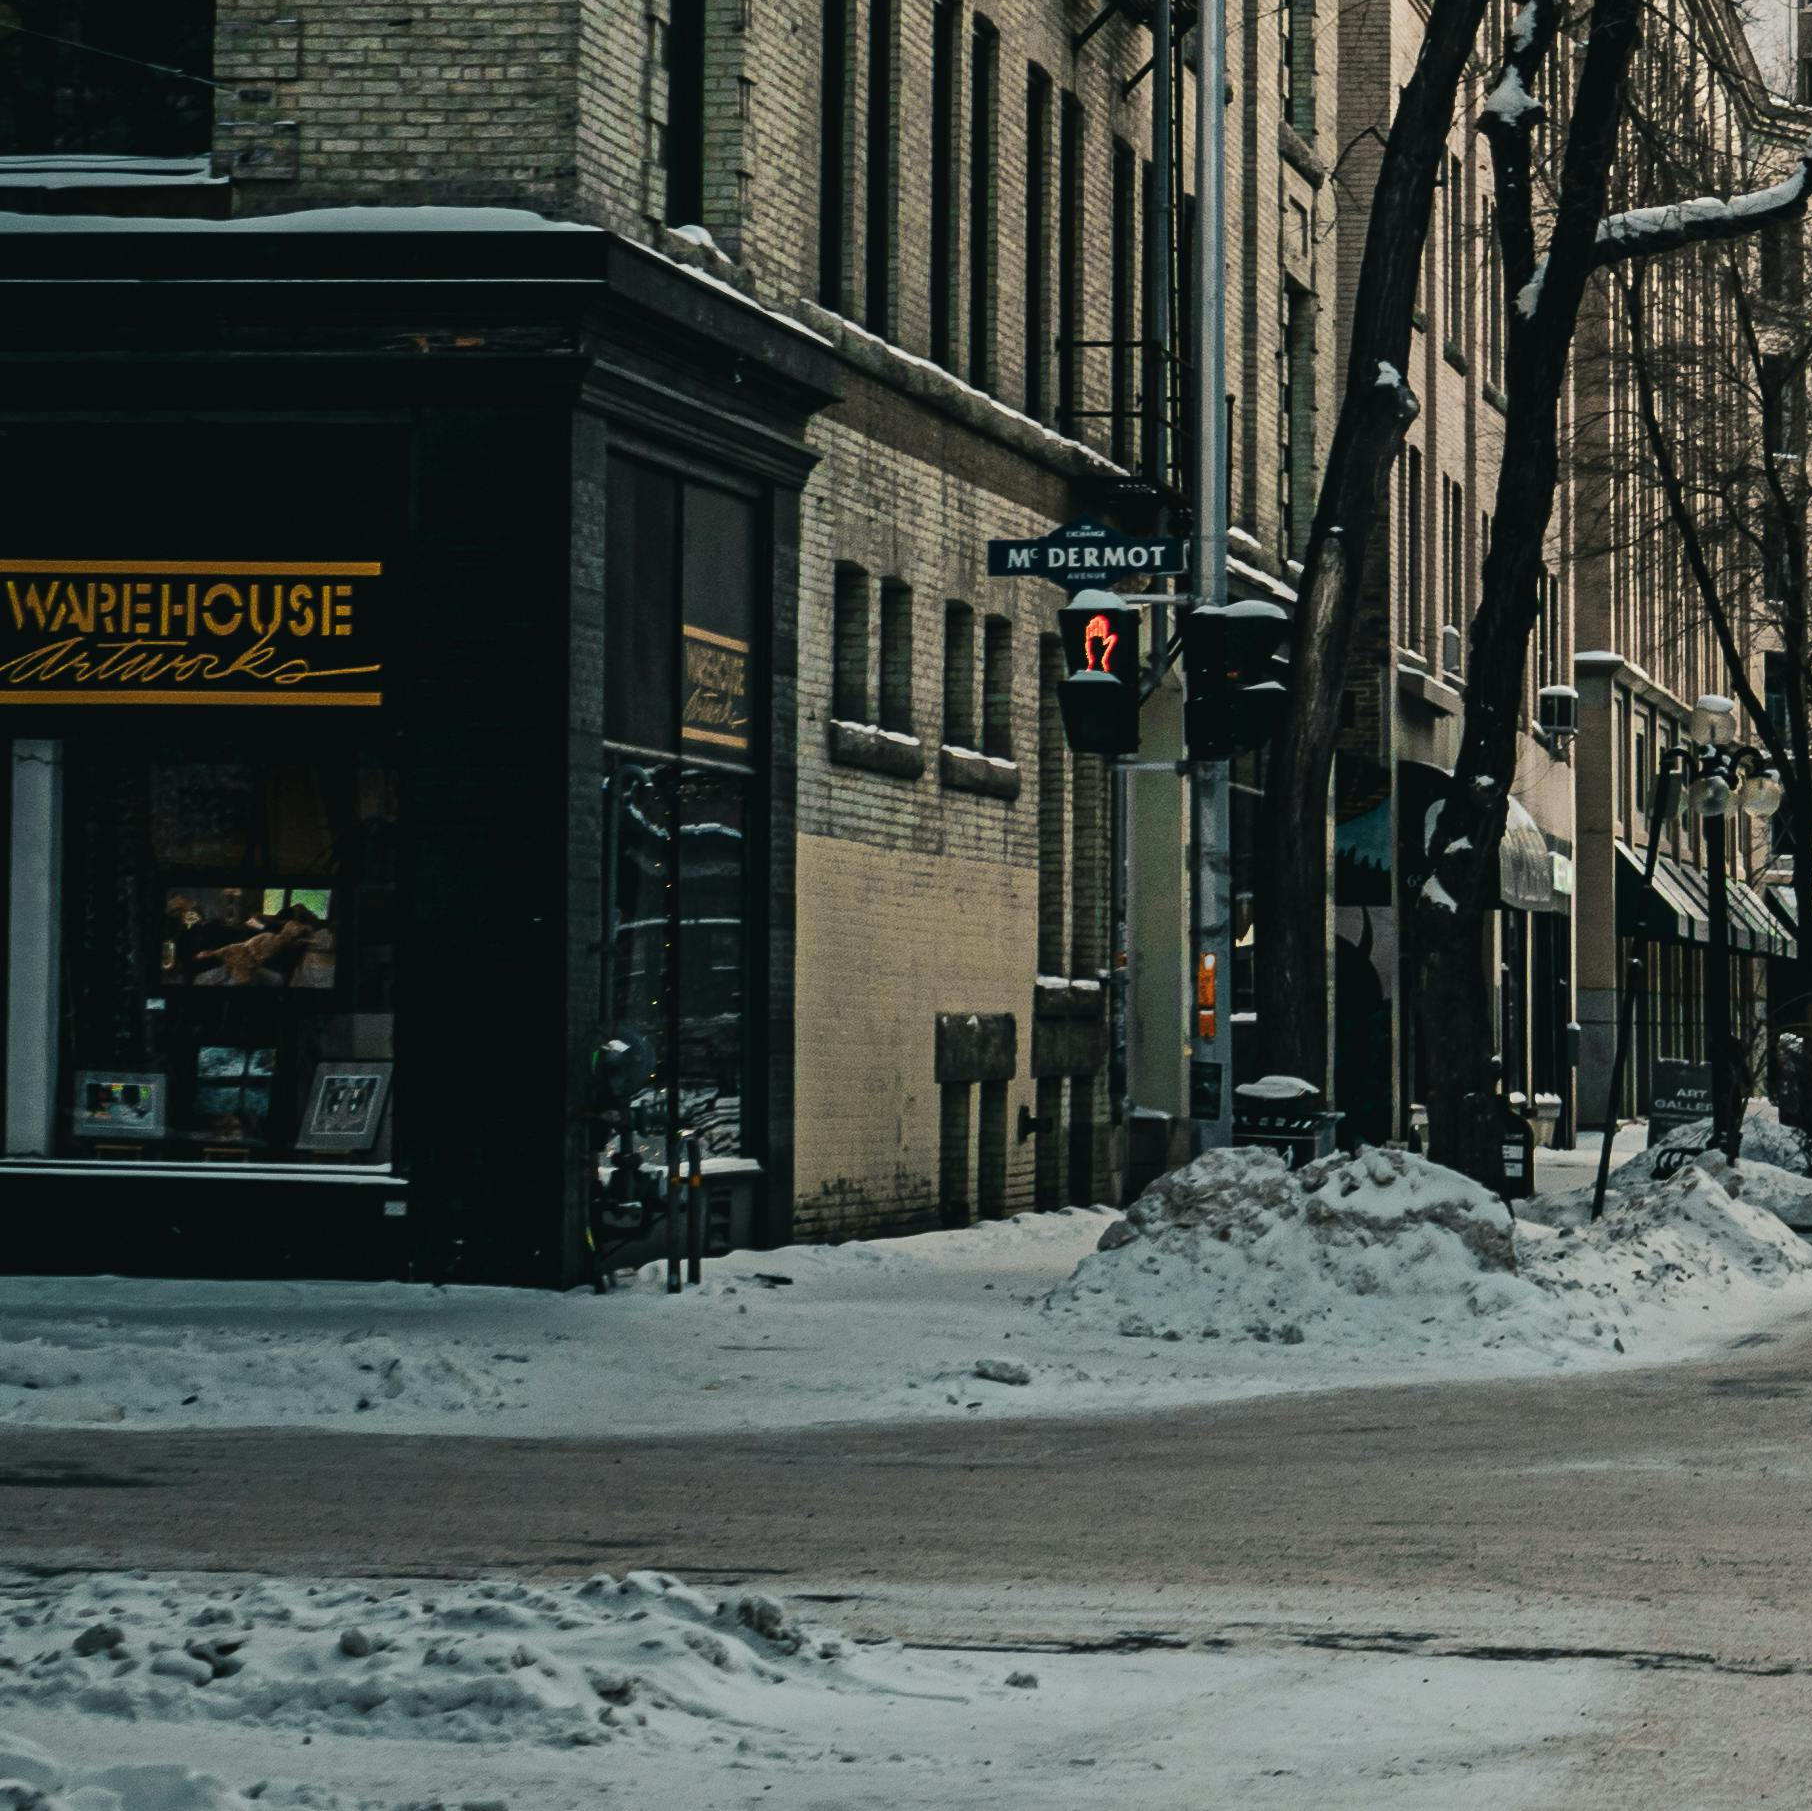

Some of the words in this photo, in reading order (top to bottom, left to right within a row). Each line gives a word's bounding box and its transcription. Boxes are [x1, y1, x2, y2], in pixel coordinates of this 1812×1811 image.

[1048, 546, 1166, 567] DERMOT
[1066, 572, 1107, 580] AVENUE
[4, 581, 353, 637] WAREHOUSE
[0, 634, 381, 685] Artworks
[1676, 1088, 1709, 1099] ART
